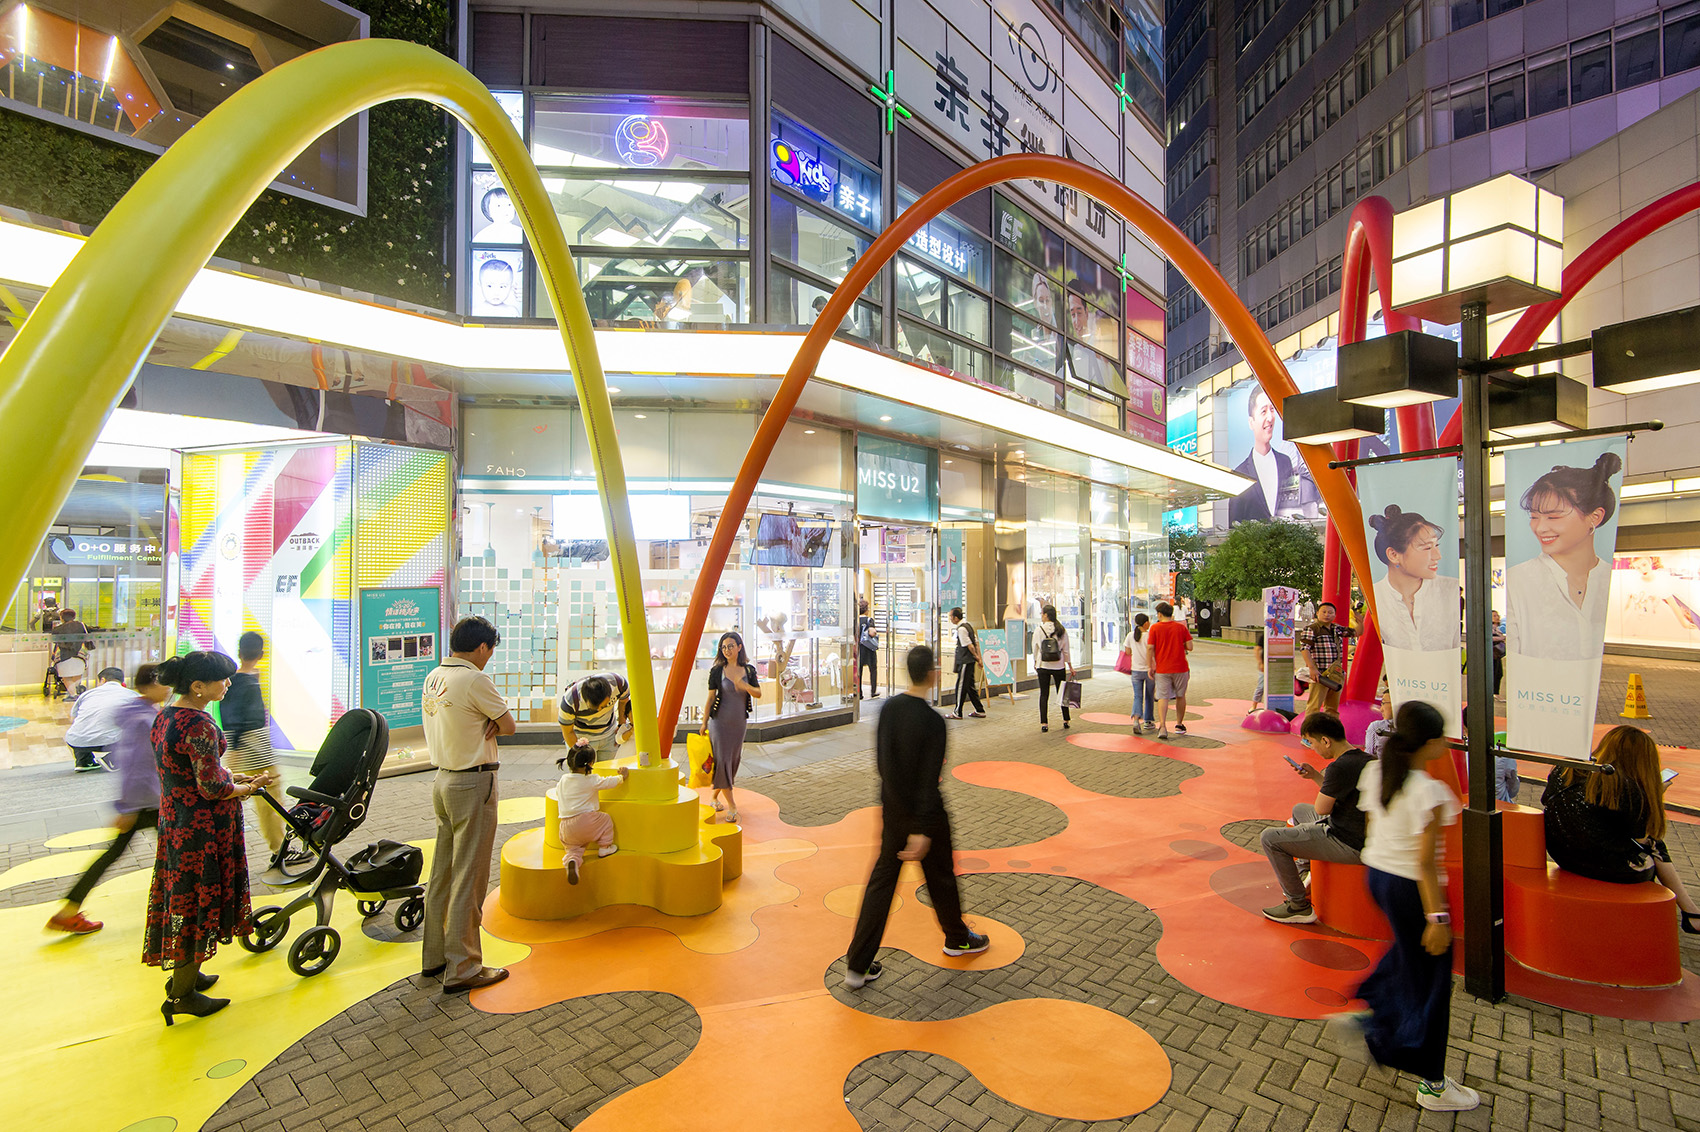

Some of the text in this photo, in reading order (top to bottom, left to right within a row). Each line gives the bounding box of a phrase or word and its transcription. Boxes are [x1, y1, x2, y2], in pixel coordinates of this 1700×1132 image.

[839, 184, 872, 218] 亲子
[1000, 210, 1024, 244] EF
[908, 229, 967, 272] 造型设计
[858, 467, 920, 494] MISS U2
[78, 542, 111, 553] O+O
[275, 575, 298, 593] EF
[1397, 678, 1448, 692] MISS U2
[1517, 689, 1582, 706] MISS U2
